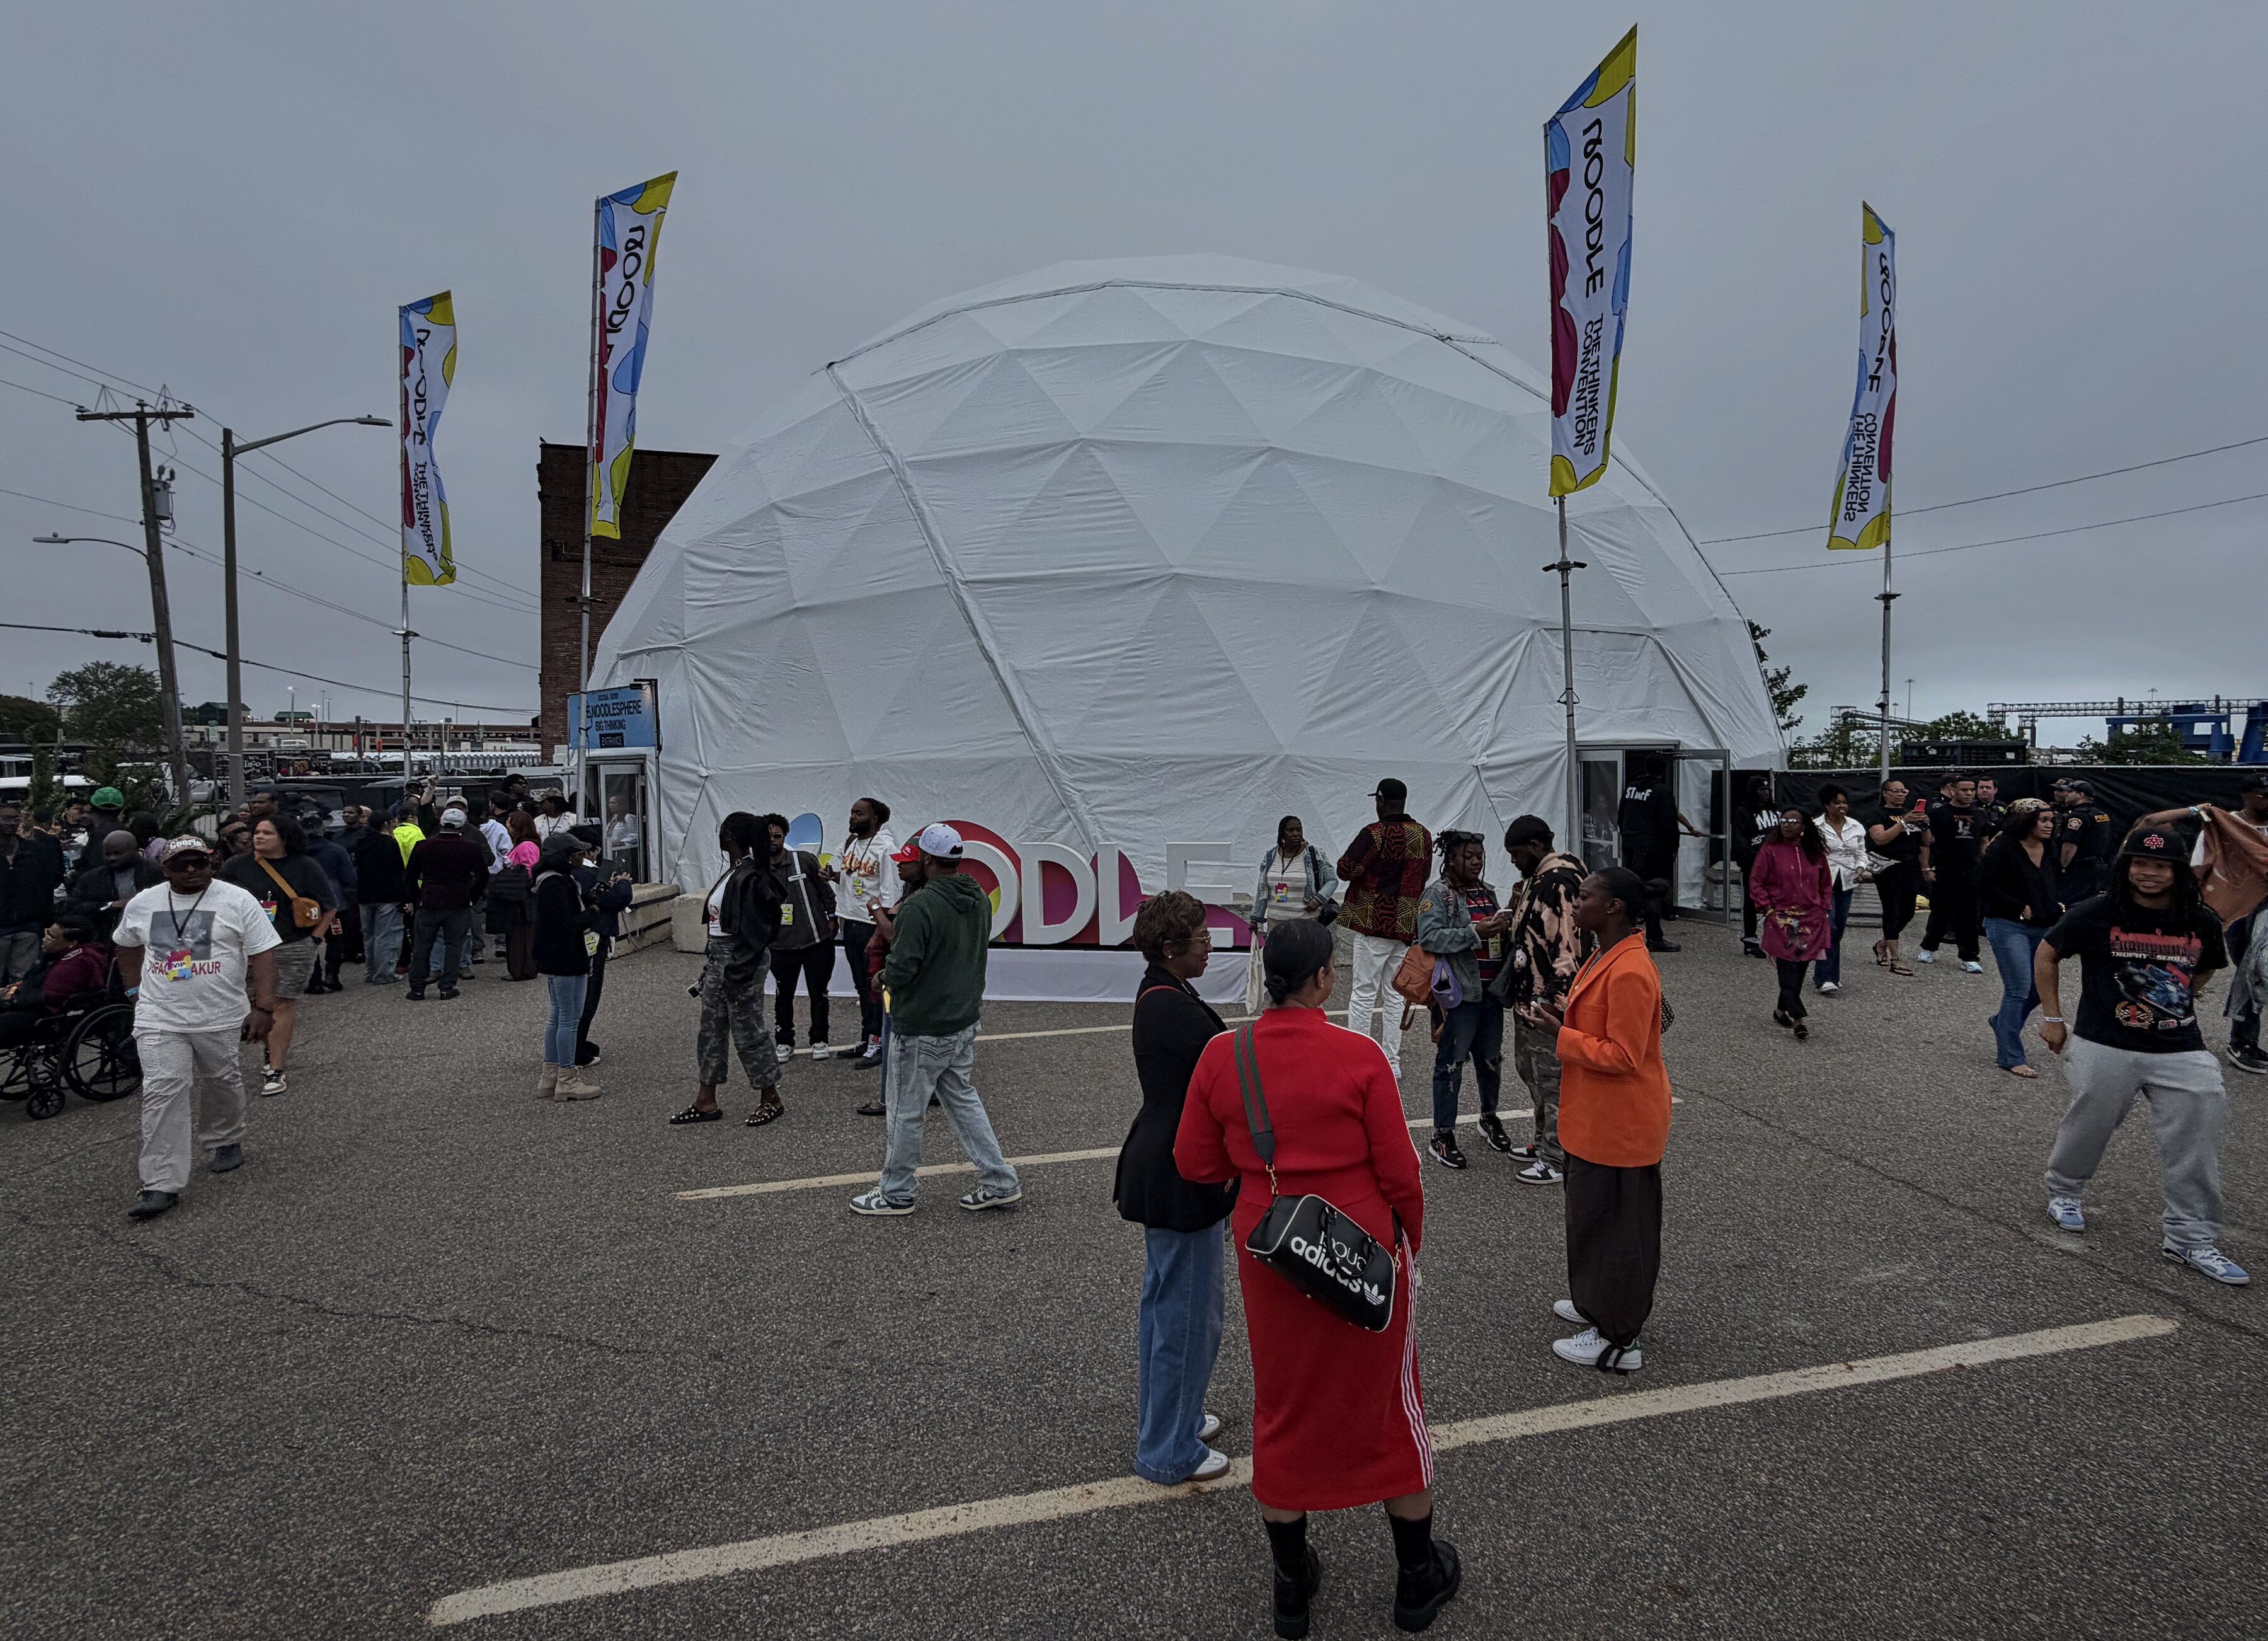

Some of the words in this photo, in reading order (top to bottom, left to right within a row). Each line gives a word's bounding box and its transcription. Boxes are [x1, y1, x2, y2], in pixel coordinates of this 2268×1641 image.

[1582, 118, 1603, 298] NOODLE
[1591, 313, 1603, 355] THE
[1573, 320, 1593, 447] CONVENTION
[1584, 355, 1599, 455] THINKERS
[418, 461, 428, 489] THE
[592, 700, 642, 718] NOODLESPHERE
[595, 721, 604, 731] BIG
[604, 719, 626, 731] THINKING
[602, 736, 622, 746] ENTRANCE
[959, 841, 1234, 948] ODLE
[191, 961, 221, 975] AKUR
[1291, 1236, 1362, 1293] adidas
